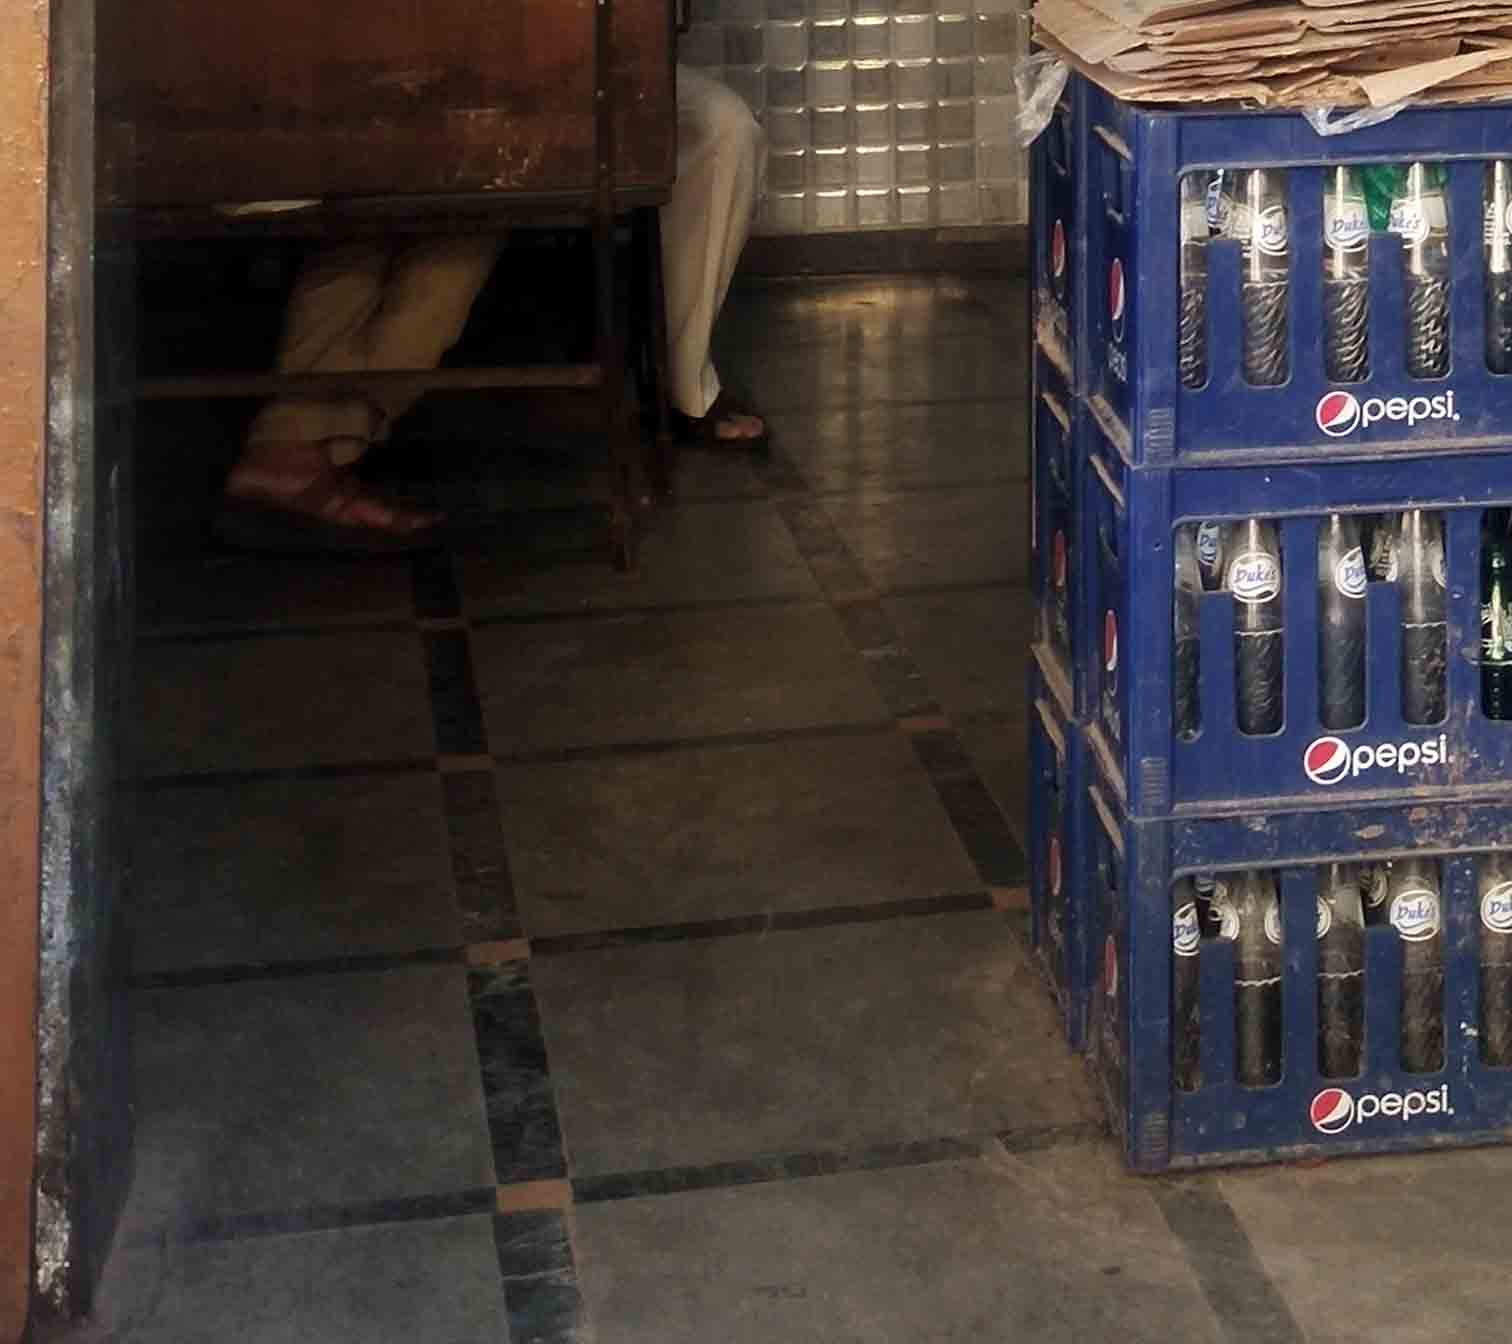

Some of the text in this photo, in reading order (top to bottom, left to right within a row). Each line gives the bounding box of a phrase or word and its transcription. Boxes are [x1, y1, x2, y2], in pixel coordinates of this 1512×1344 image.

[1362, 390, 1454, 426] pepsi
[1352, 735, 1447, 775] pepsi
[1356, 1085, 1448, 1125] pepsi
